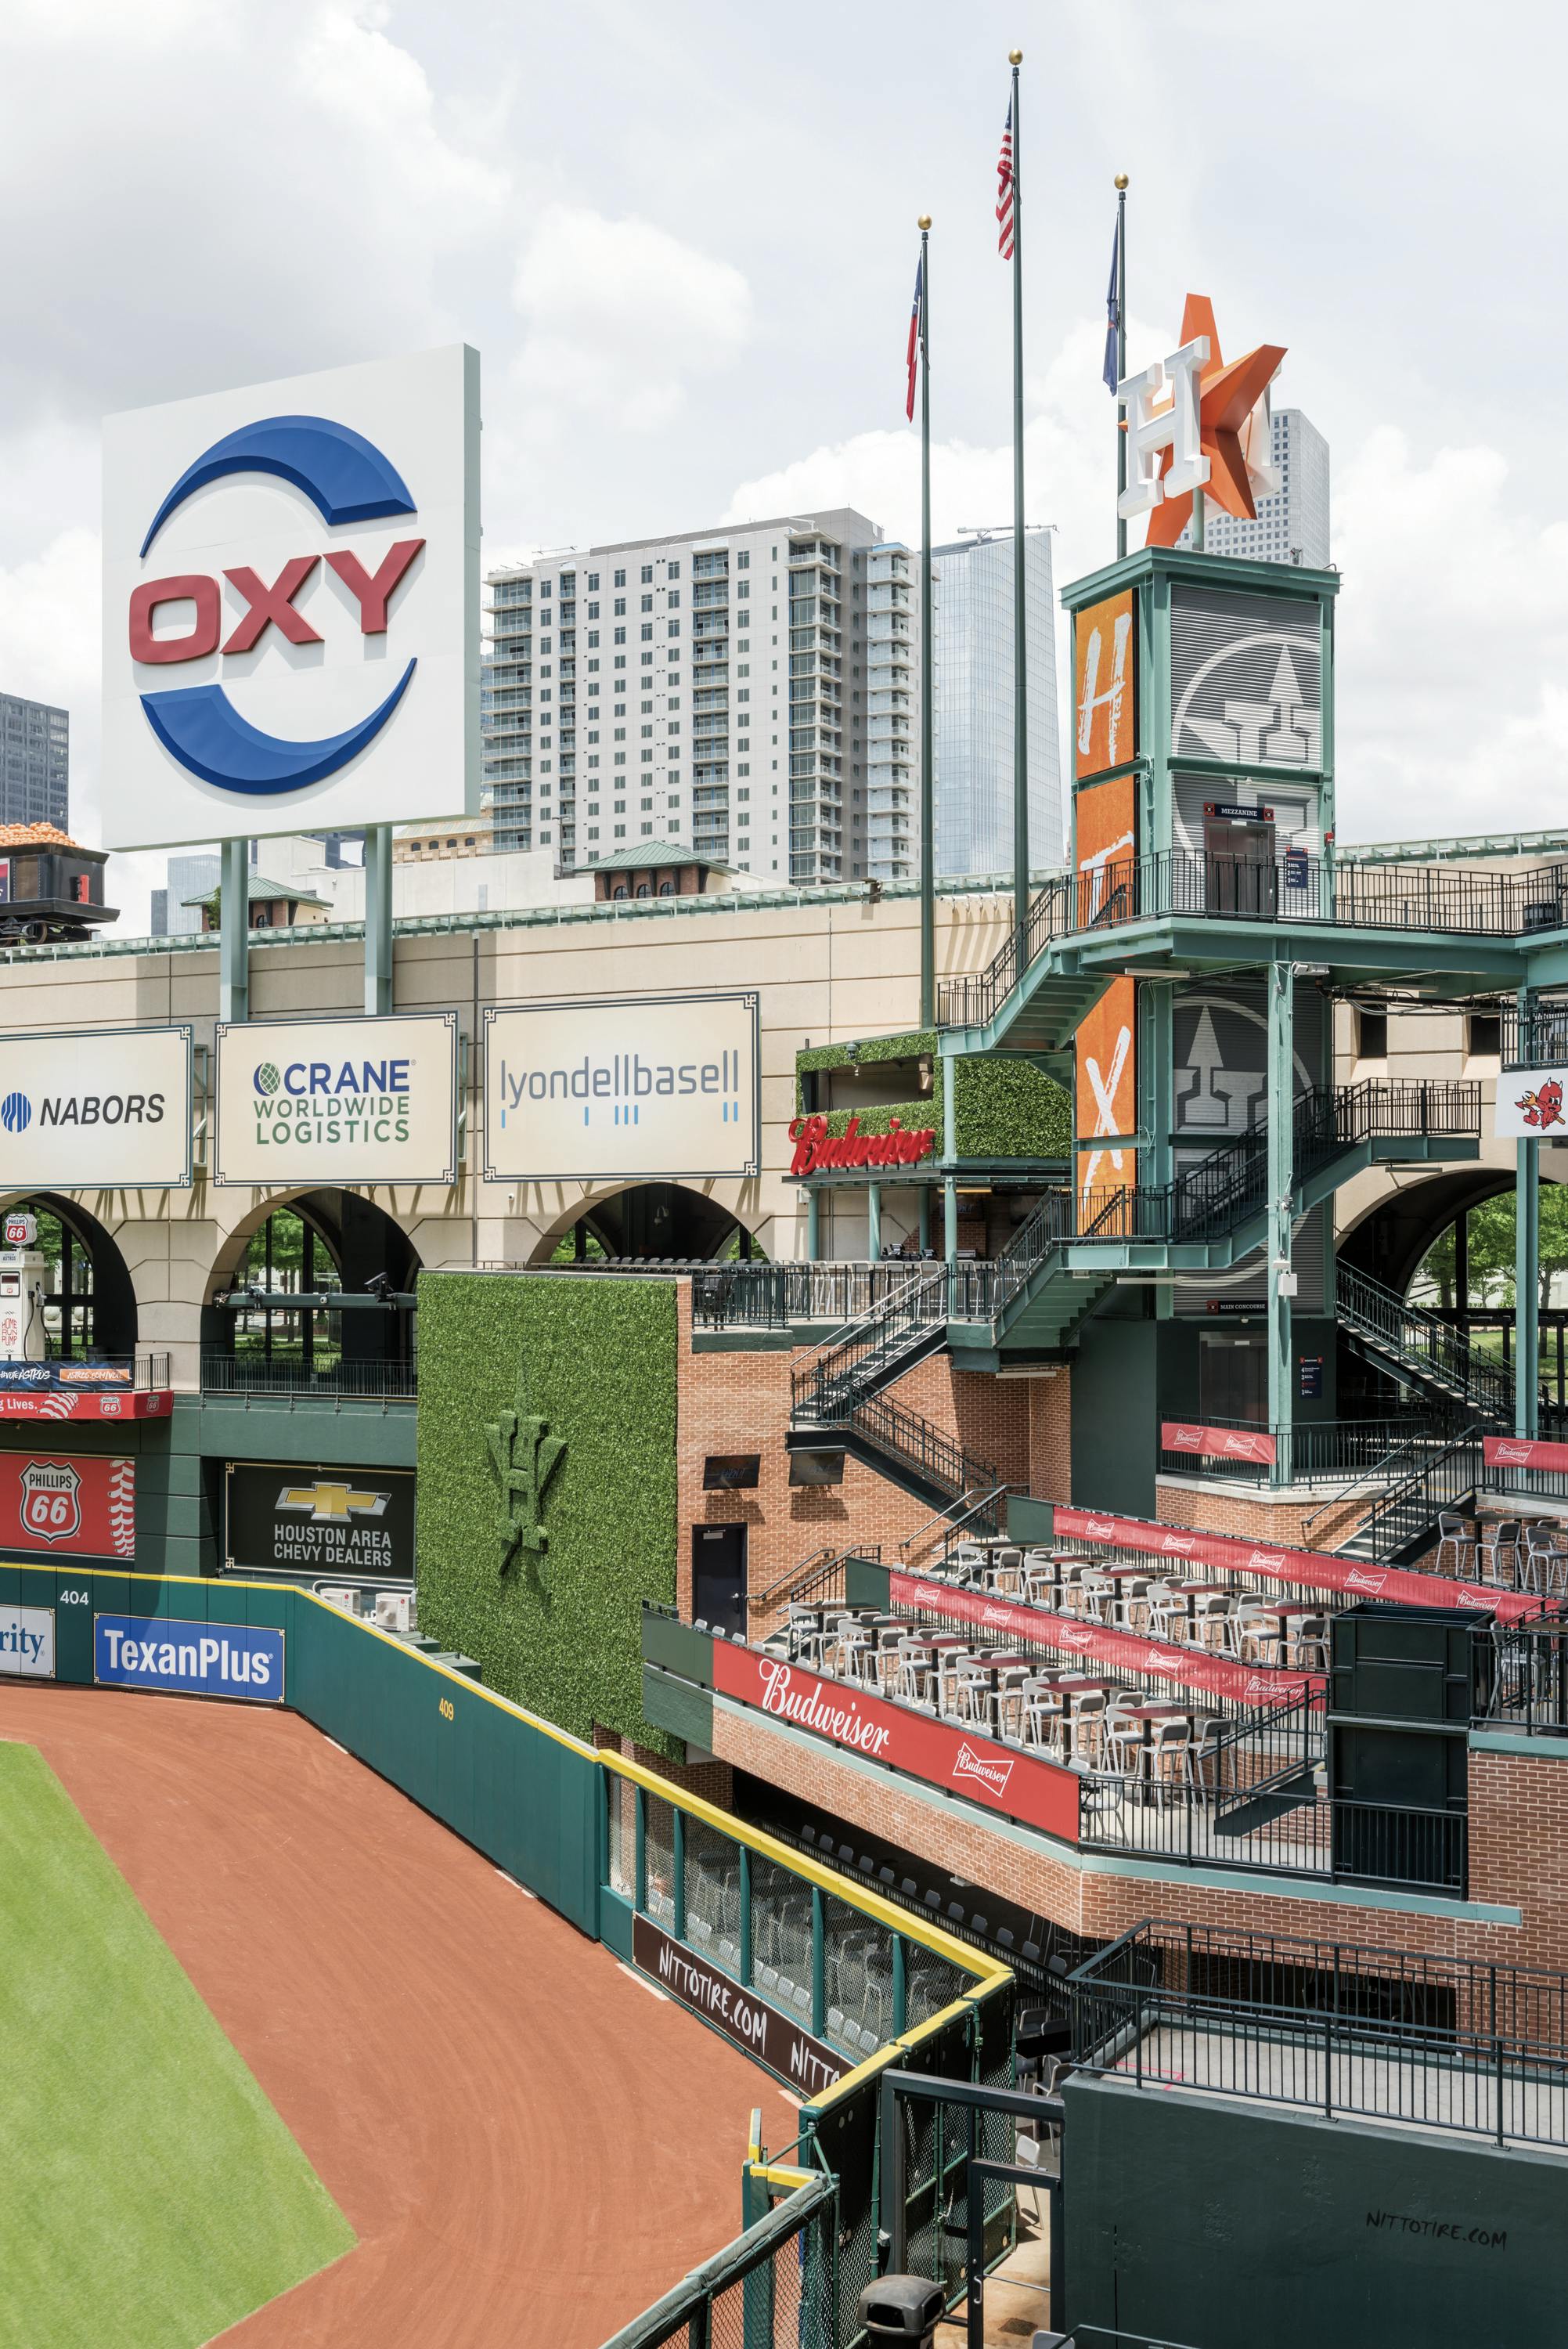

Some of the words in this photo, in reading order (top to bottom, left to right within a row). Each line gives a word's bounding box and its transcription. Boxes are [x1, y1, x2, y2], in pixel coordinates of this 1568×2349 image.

[128, 538, 427, 665] OXY
[1221, 807, 1258, 817] MEZZANINE
[283, 1059, 409, 1095] CRANE
[501, 1049, 738, 1109] lyondellbasell
[39, 1093, 164, 1127] NABORS
[254, 1096, 409, 1118] WORLDWIDE
[257, 1119, 409, 1144] LOGISTICS
[788, 1115, 936, 1175] Budweiser
[9, 1227, 24, 1239] 66
[2, 1335, 17, 1346] PUMP
[7, 1398, 38, 1410] Lives.
[1227, 1438, 1253, 1449] Budweiser
[1498, 1445, 1529, 1457] Budweiser
[29, 1473, 72, 1488] PHILLIPS
[31, 1495, 69, 1525] 66
[274, 1524, 346, 1545] HOUSTON
[350, 1529, 391, 1549] AREA
[274, 1543, 322, 1561] CHEVY
[326, 1546, 391, 1567] DEALERS
[1253, 1553, 1281, 1567] Budweiser
[1348, 1572, 1382, 1588] Budweiser
[59, 1590, 89, 1605] 404
[1458, 1594, 1496, 1611] Budweiser
[104, 1629, 270, 1684] TexanPlus
[1148, 1652, 1179, 1669] Budweiser
[759, 1658, 889, 1754] Budweiser
[957, 1749, 1007, 1784] Budweiser
[659, 1941, 767, 2055] NITTOTIRE.COM
[1366, 2209, 1508, 2252] NITTOTIRE.COM
